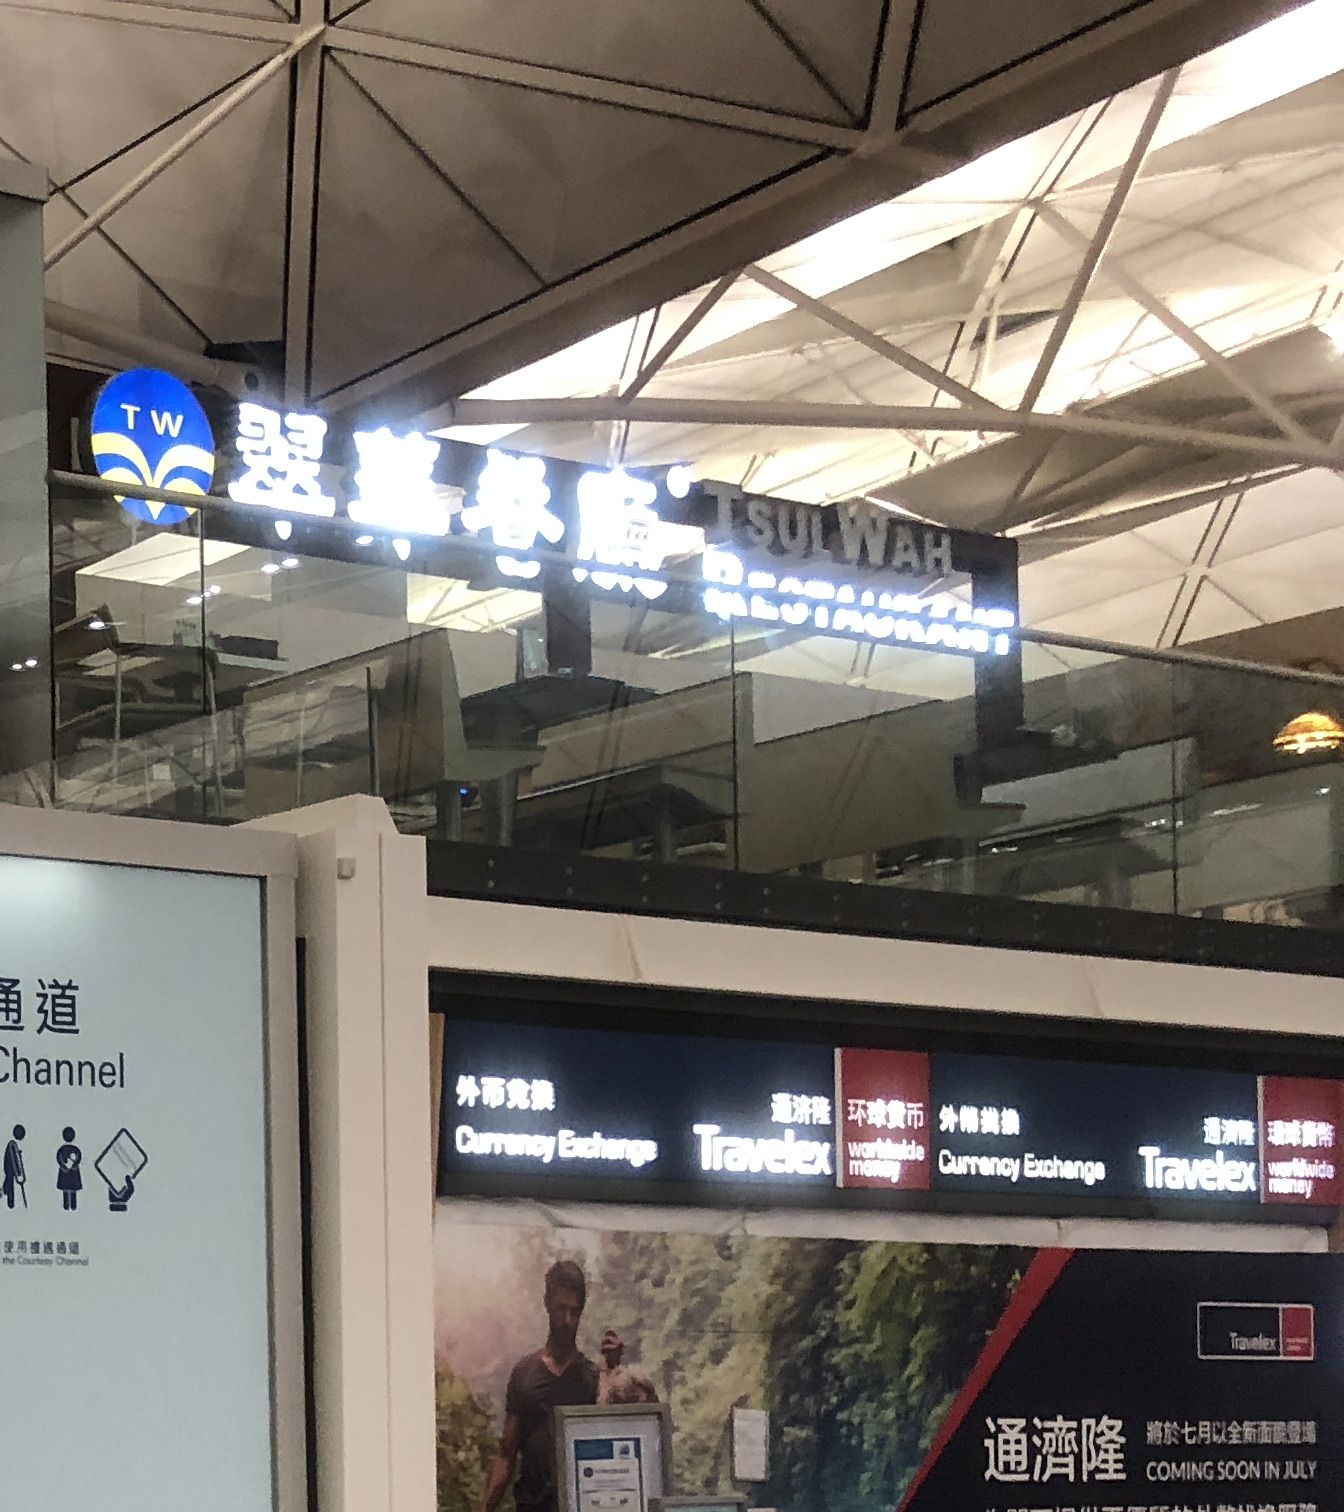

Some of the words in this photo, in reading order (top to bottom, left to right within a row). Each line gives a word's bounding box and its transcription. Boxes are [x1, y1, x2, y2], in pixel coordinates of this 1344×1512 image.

[703, 480, 832, 552] TSUI
[836, 497, 953, 574] WAH
[455, 1125, 558, 1164] Currency
[558, 1130, 659, 1168] Exchange
[692, 1124, 833, 1176] Travelex
[938, 1149, 1021, 1182] Currency
[1023, 1153, 1106, 1185] Exchange
[1138, 1145, 1257, 1192] Travelex
[1268, 1177, 1313, 1199] money
[1229, 1332, 1277, 1351] Travelex
[983, 1414, 1127, 1482] 通濟隆
[1146, 1460, 1214, 1482] COMING
[1216, 1460, 1261, 1481] SOON
[1264, 1460, 1281, 1480] IN
[1283, 1459, 1317, 1480] JULY
